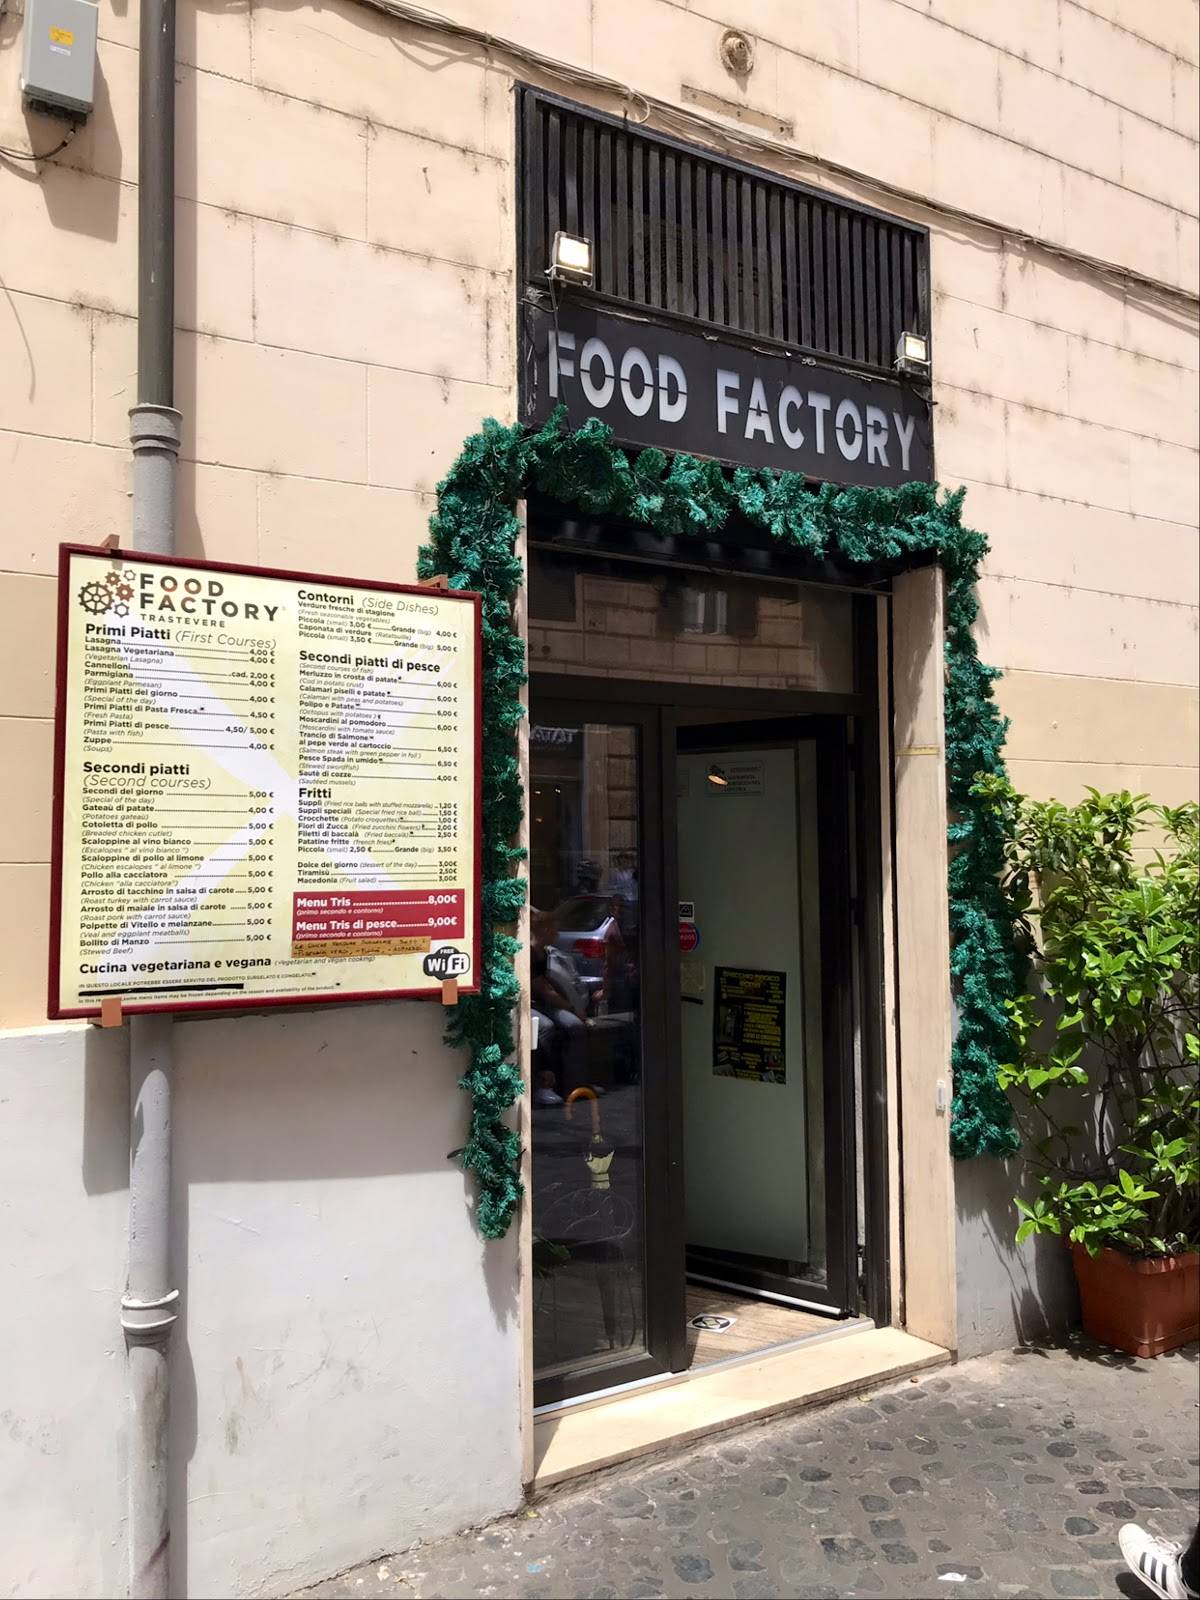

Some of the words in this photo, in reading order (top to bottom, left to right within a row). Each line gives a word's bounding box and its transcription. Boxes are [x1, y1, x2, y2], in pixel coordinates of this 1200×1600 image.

[548, 330, 688, 423] FOOD
[716, 368, 916, 471] FACTORY
[140, 573, 224, 597] FOOD
[140, 592, 278, 621] FACTORY
[298, 590, 354, 605] Contorni
[362, 597, 393, 610] (Side
[396, 600, 439, 616] Dishes)
[140, 613, 225, 628] TRASTEVERE
[85, 636, 121, 645] Lasagna
[86, 623, 126, 636] Primi
[131, 627, 170, 640] Piatti
[175, 630, 213, 644] (First
[217, 634, 276, 651] Courses)
[85, 644, 121, 653] Lasagna
[123, 647, 174, 656] Vegetariana
[84, 661, 131, 670] Cannelloni
[299, 650, 351, 664] Secondi
[355, 656, 388, 668] piatti
[392, 659, 403, 669] di
[407, 662, 440, 673] pesce
[84, 669, 134, 679] Parmigiana
[109, 687, 133, 695] Piatti
[134, 688, 148, 696] del
[84, 702, 107, 710] Primi
[145, 705, 168, 713] Pasta
[84, 719, 107, 727] Primi
[109, 720, 132, 728] Piatti
[299, 716, 339, 724] Moscardini
[83, 736, 112, 744] Zuppe
[83, 761, 145, 774] Secondi
[150, 763, 189, 776] piatti
[83, 774, 147, 789] (Second
[150, 776, 211, 790] courses)
[136, 788, 164, 796] giorno
[299, 788, 331, 798] Fritti
[136, 821, 158, 829] pollo
[82, 838, 130, 846] Scaloppine
[81, 854, 130, 863] Scaloppine
[81, 871, 104, 879] Pollo
[297, 898, 328, 907] Menu
[330, 897, 351, 906] Tris
[428, 894, 457, 905] 8,00€
[127, 904, 155, 912] maiale
[80, 922, 118, 930] Polpette
[296, 921, 327, 931] Menu
[329, 920, 350, 930] Tris
[352, 920, 363, 929] di
[366, 920, 397, 930] pesce
[428, 916, 457, 927] 9,00€
[80, 939, 109, 947] Bollito
[80, 962, 127, 974] Cucina
[131, 960, 210, 973] vegetariana
[214, 960, 222, 968] e
[226, 958, 271, 969] vegana
